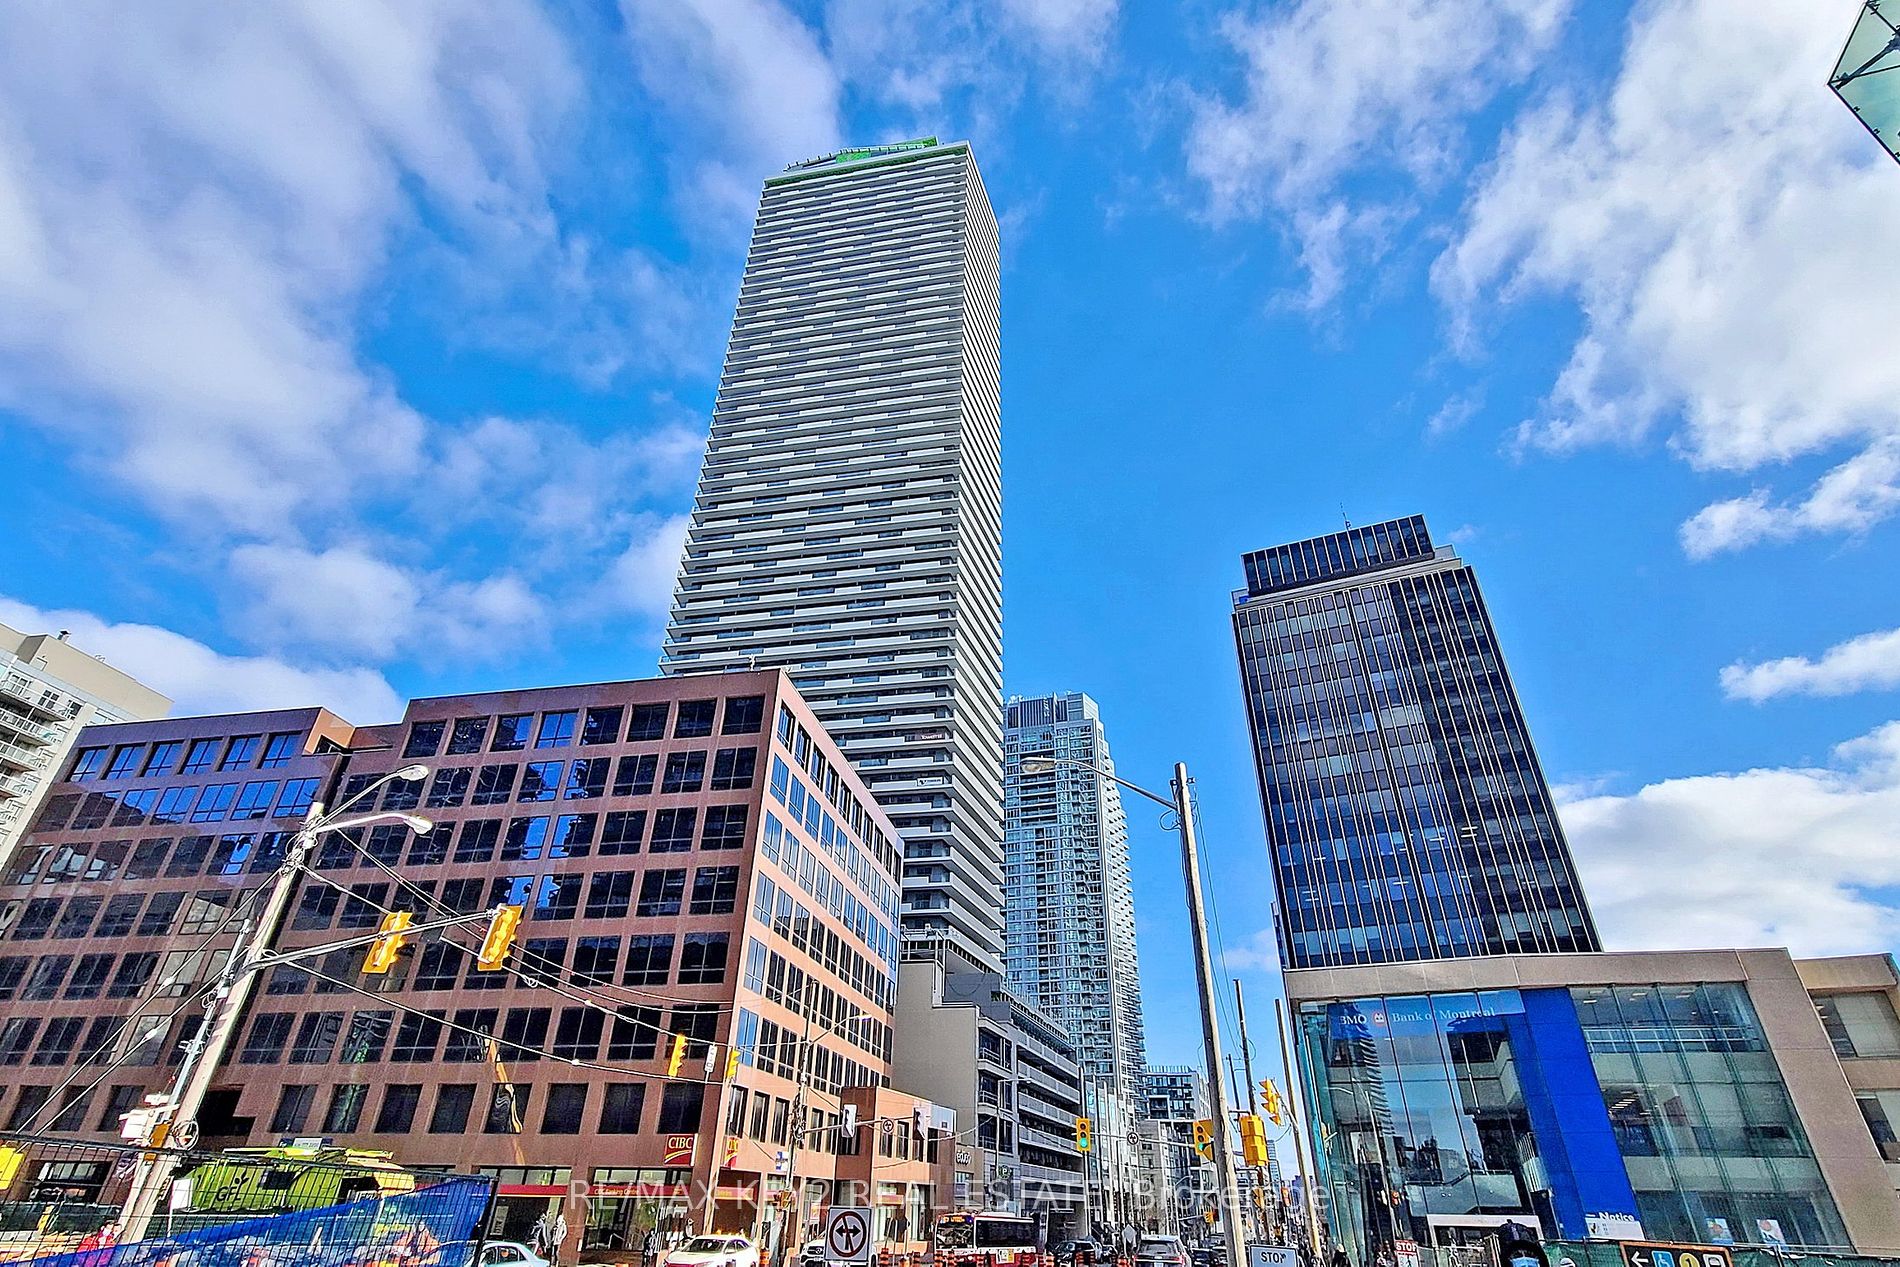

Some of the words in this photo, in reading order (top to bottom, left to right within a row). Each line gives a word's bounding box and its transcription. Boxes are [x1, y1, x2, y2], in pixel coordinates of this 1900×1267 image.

[1392, 1011, 1422, 1022] Bank
[1439, 1007, 1495, 1020] Montreal
[668, 1137, 694, 1149] CIBC
[217, 1186, 241, 1202] GFL
[1599, 1212, 1635, 1222] Notice
[1396, 1242, 1418, 1252] STOP
[1261, 1251, 1287, 1264] STOP
